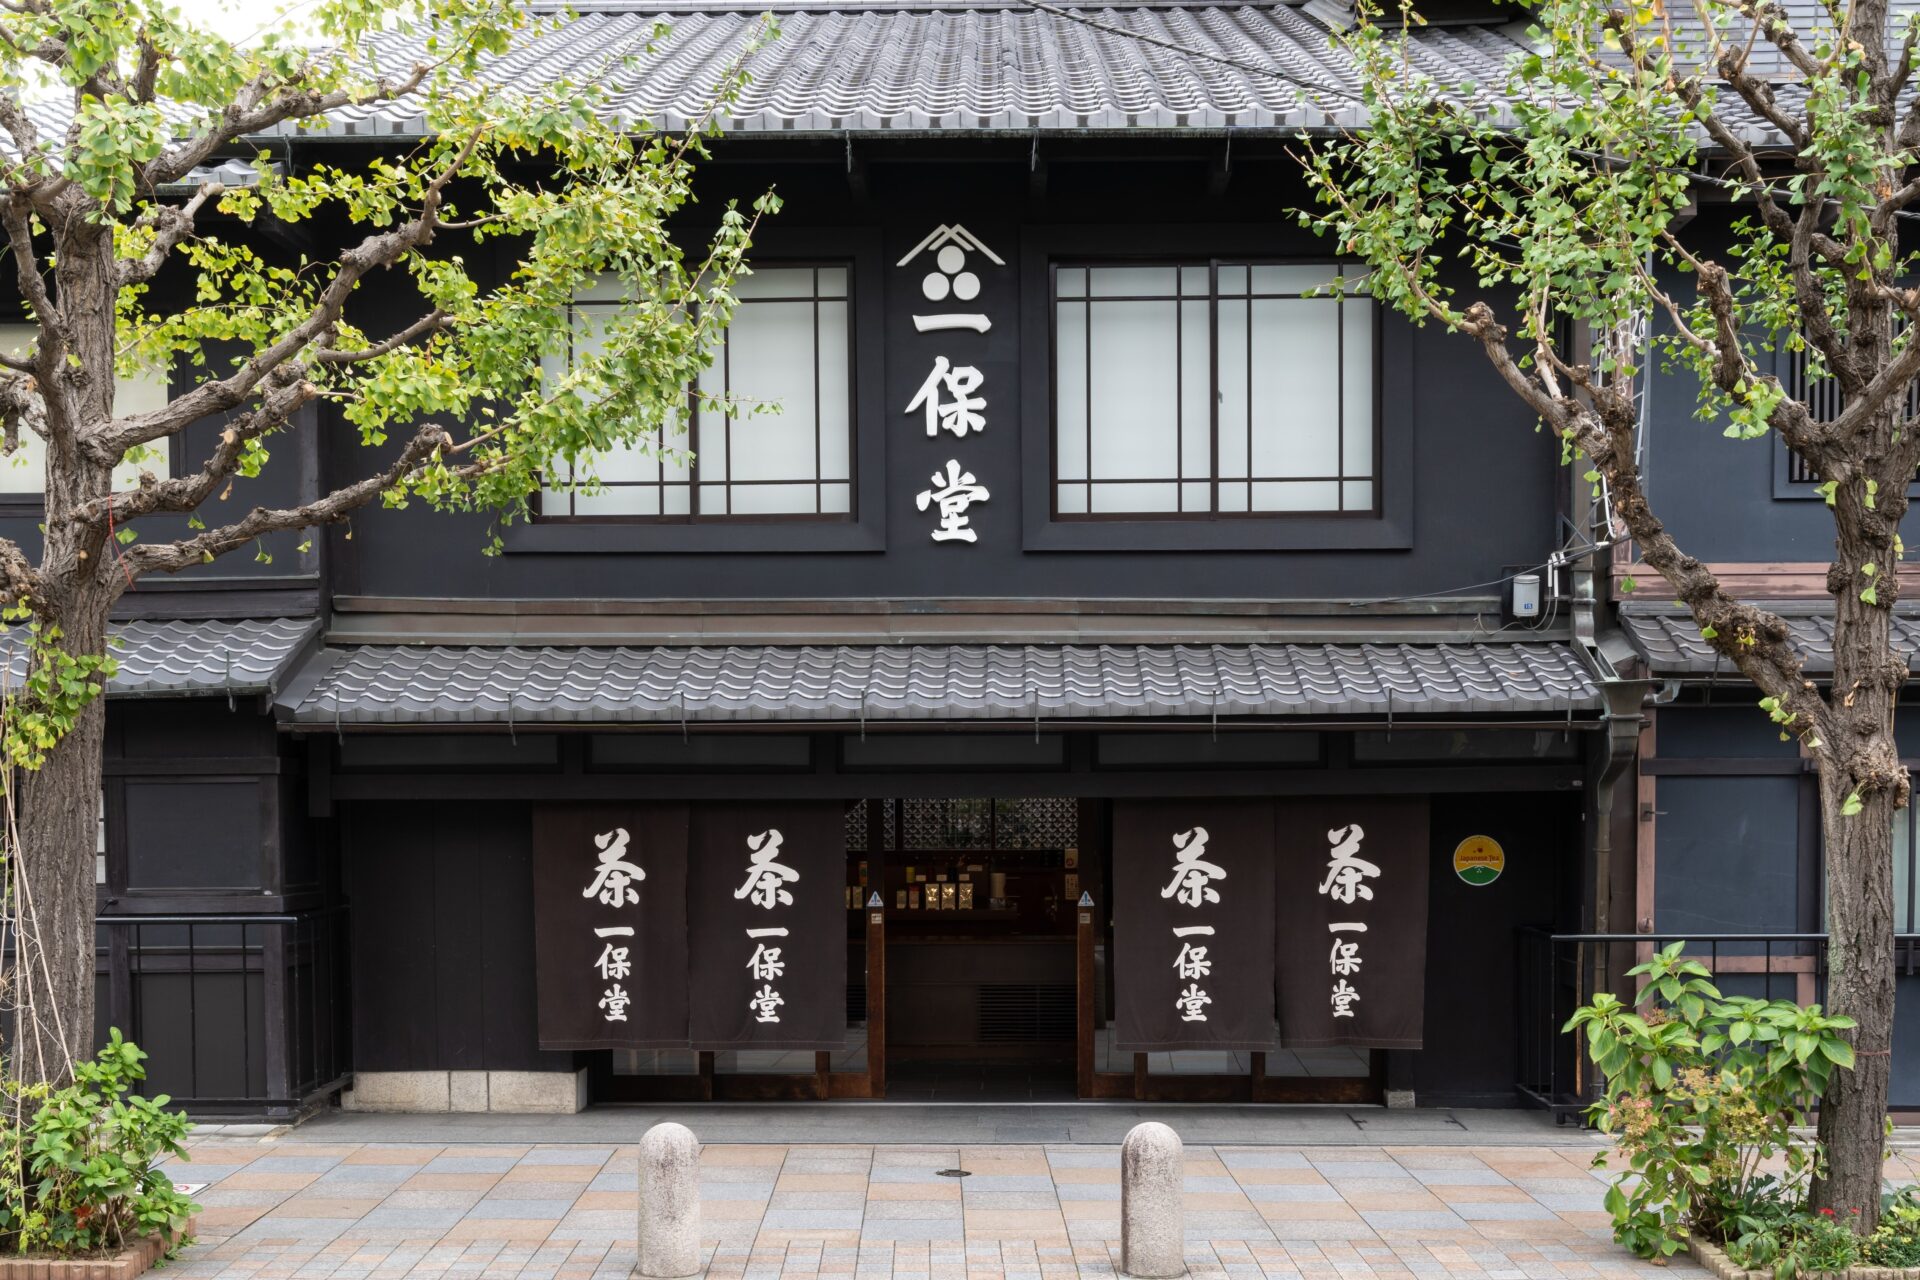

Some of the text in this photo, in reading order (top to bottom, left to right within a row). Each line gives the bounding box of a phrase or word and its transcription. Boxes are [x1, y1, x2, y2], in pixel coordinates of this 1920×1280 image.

[904, 313, 992, 543] 一保堂
[1460, 855, 1488, 863] Japanese
